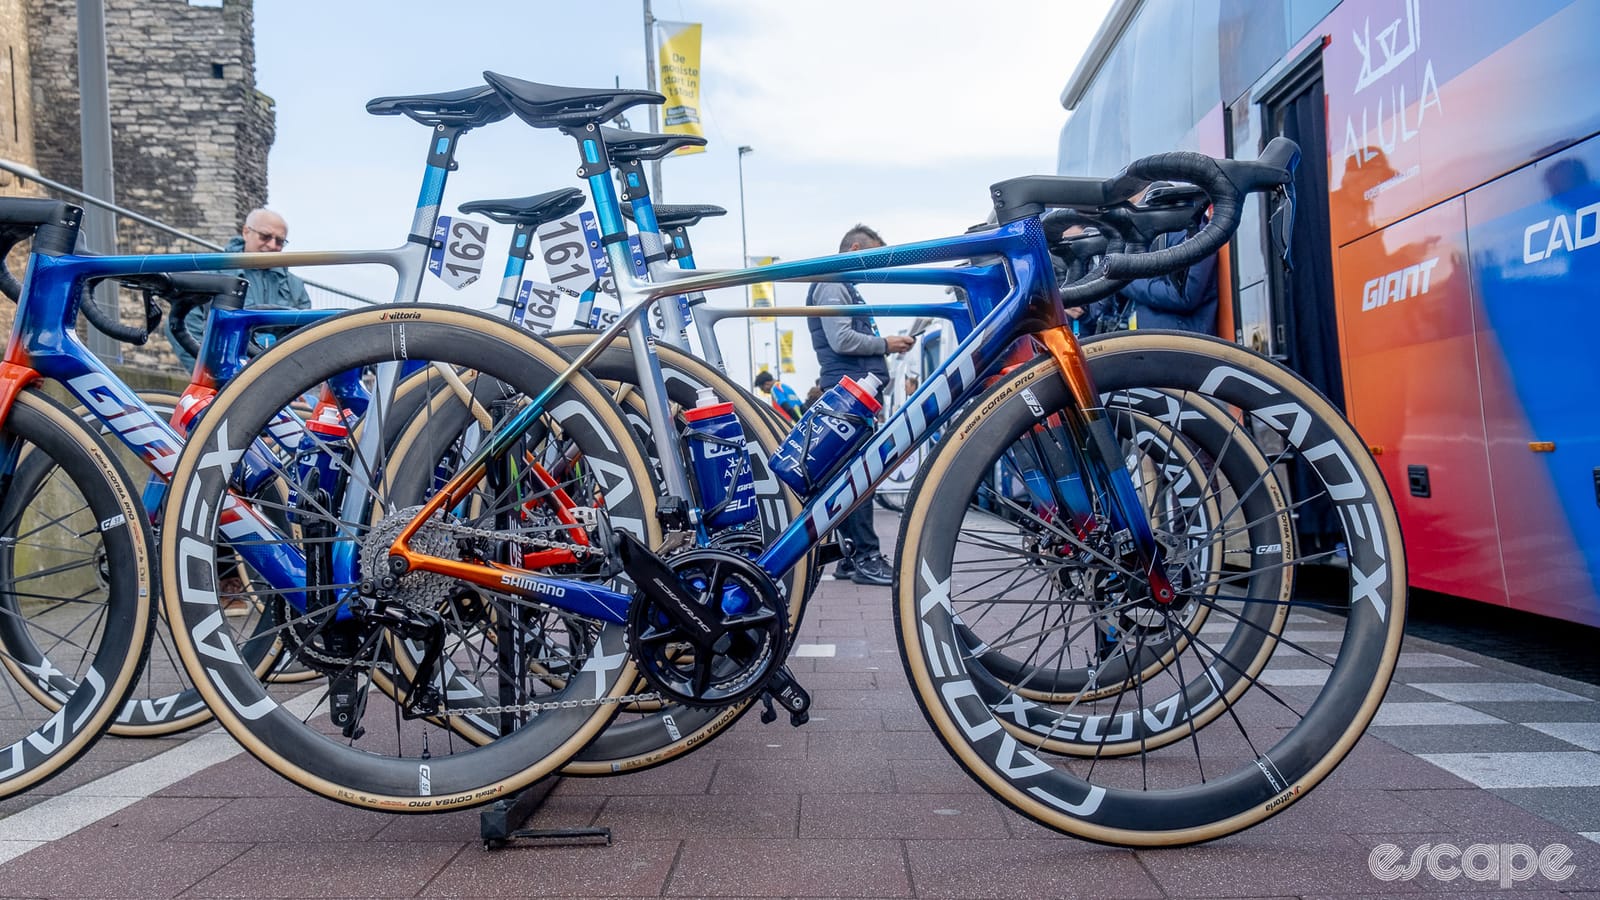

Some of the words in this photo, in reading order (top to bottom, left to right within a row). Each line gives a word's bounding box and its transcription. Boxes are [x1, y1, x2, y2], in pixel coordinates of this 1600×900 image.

[662, 66, 698, 76] mooiste
[672, 53, 685, 63] De
[687, 78, 696, 88] in
[1343, 58, 1442, 169] ALULA
[446, 222, 489, 277] 162
[539, 221, 590, 284] 161
[1361, 256, 1439, 312] GIANT
[389, 311, 422, 320] vittoria
[524, 288, 560, 331] 164
[982, 387, 1013, 416] CORSA
[1014, 371, 1035, 389] PRO
[812, 328, 986, 538] GIANT
[107, 470, 126, 500] CORSA
[123, 501, 135, 521] PRO
[1198, 365, 1387, 624] CADEX
[180, 418, 279, 721] CADEX
[500, 574, 566, 598] SHIMANO
[919, 556, 1107, 817] CADEX
[990, 665, 1225, 743] CADEX
[408, 800, 431, 808] PRO
[435, 794, 473, 807] CORSA
[1265, 790, 1294, 811] vittoria
